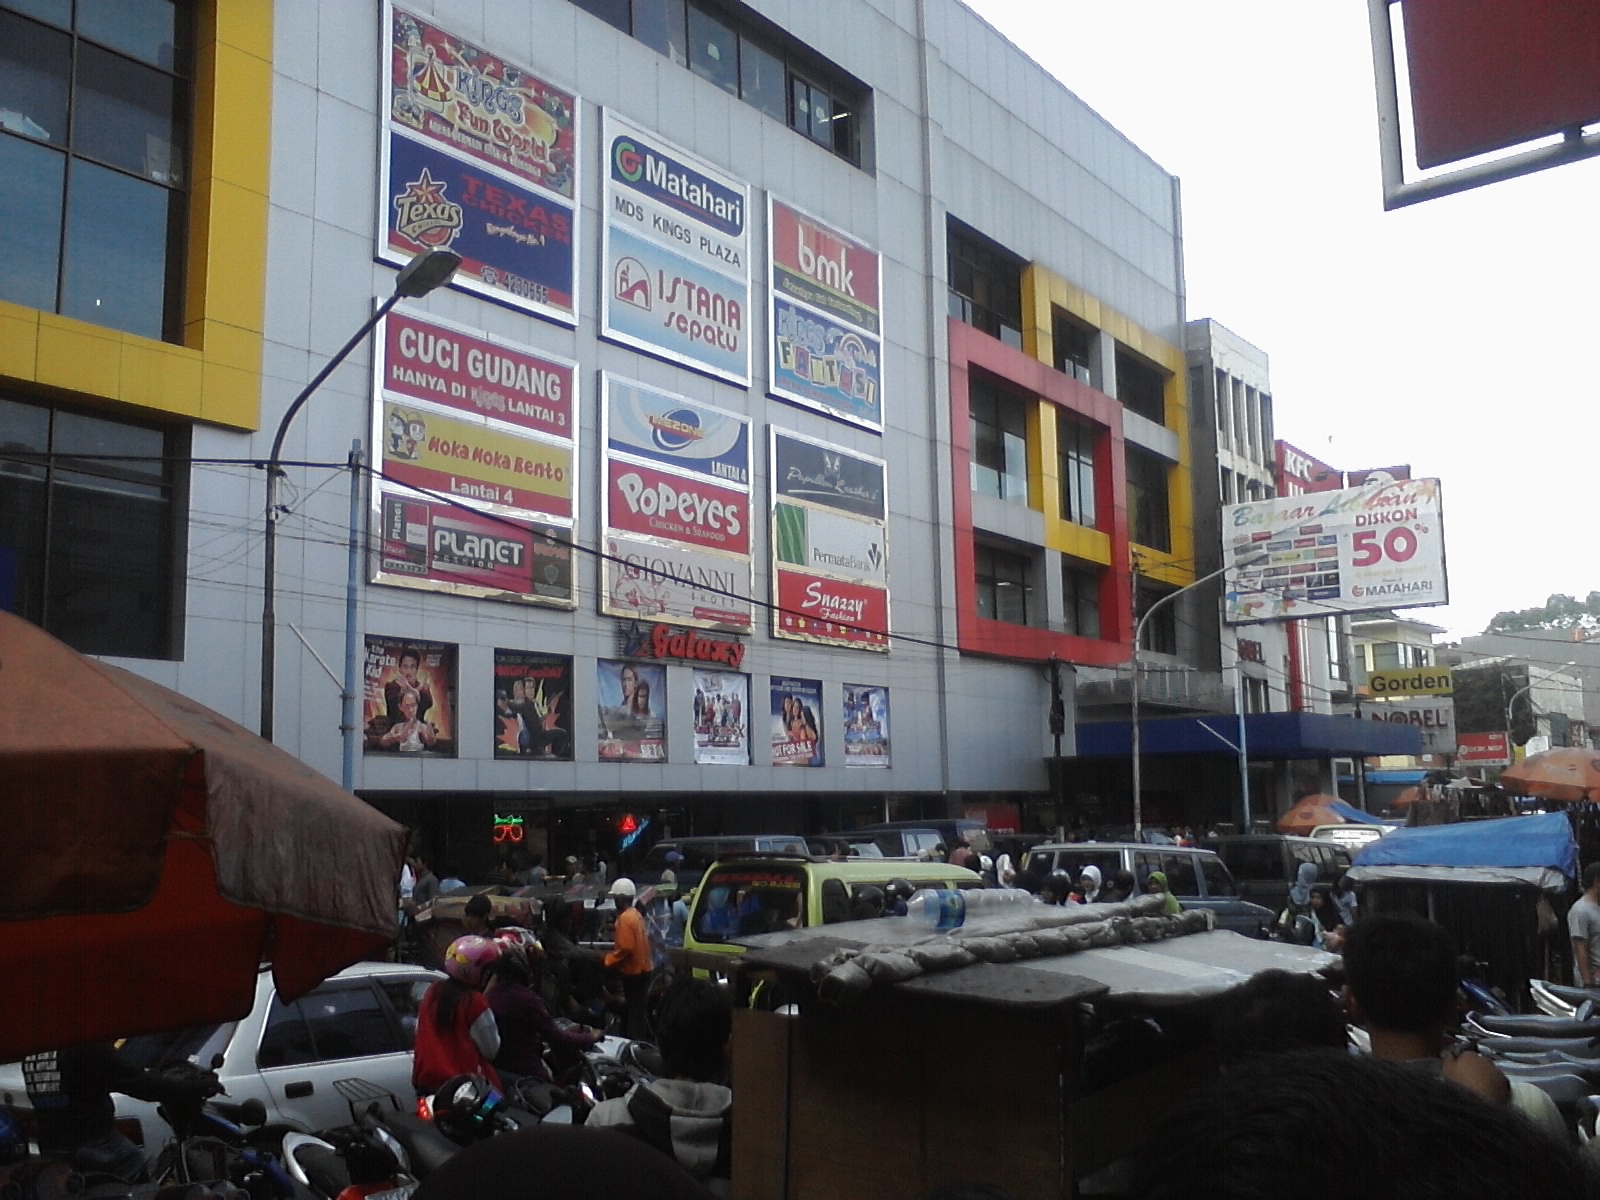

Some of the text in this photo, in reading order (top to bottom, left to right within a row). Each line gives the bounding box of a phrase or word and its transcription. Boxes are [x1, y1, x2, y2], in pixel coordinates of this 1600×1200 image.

[456, 100, 490, 134] Fun
[492, 118, 549, 163] World
[463, 174, 570, 234] TEXAS
[646, 153, 741, 226] Matahari
[398, 196, 460, 228] Texas
[615, 195, 742, 269] MDS KINGS PLAZA
[797, 223, 855, 297] bmk
[658, 268, 741, 331] ISTANA
[663, 311, 738, 353] sepatu
[399, 327, 562, 401] CUCI GUDANG
[392, 364, 447, 394] HANYA
[451, 381, 466, 398] DI
[508, 398, 554, 426] LANTAI
[557, 412, 566, 426] 3
[513, 456, 564, 482] Bento
[711, 460, 747, 482] LANTAI 4
[1284, 448, 1313, 483] KFC
[450, 476, 514, 504] Lantai 4
[1355, 507, 1418, 527] DISKON
[624, 552, 736, 597] GIOVANNI
[1366, 580, 1433, 597] MATAHARI
[802, 581, 864, 621] Snazzy
[652, 622, 746, 669] Galaxy
[1371, 673, 1450, 692] Gorden
